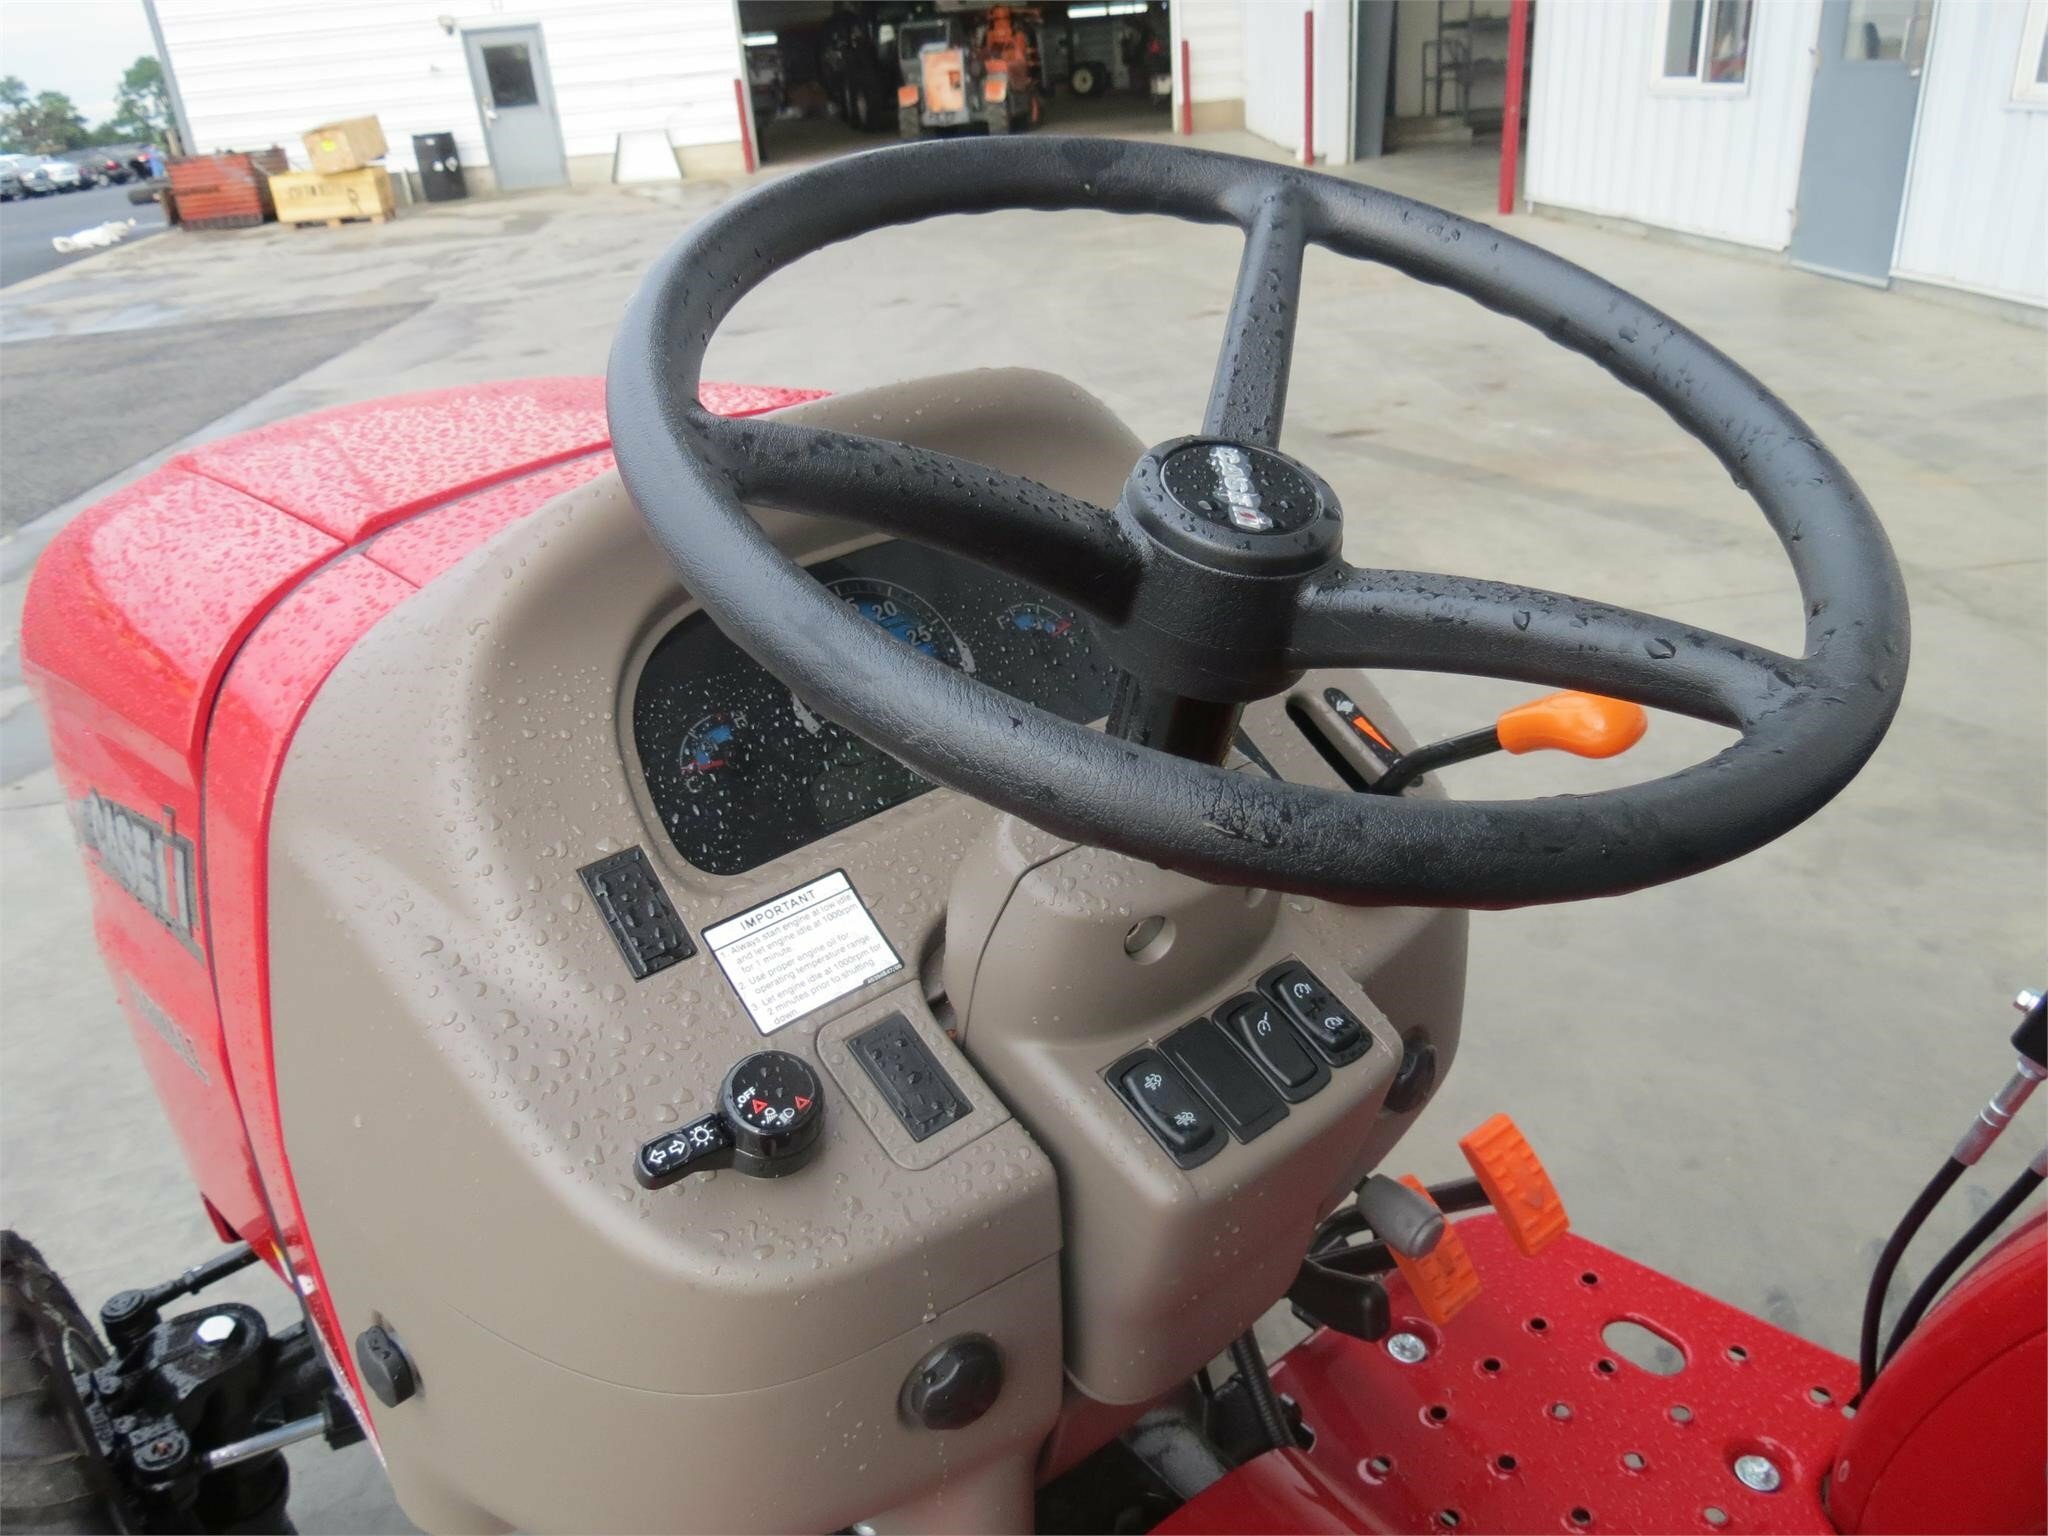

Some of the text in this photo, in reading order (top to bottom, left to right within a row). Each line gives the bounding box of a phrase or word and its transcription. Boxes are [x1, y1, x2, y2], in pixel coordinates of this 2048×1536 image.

[871, 600, 898, 621] 20
[906, 625, 932, 646] 25
[686, 775, 702, 793] C
[730, 937, 761, 954] Always
[761, 927, 781, 940] start
[782, 914, 810, 931] engine
[811, 908, 820, 917] at
[819, 902, 836, 912] low
[740, 889, 815, 930] IMPORTANT
[736, 951, 753, 965] and
[753, 946, 766, 955] let
[766, 933, 795, 950] engine
[796, 925, 813, 936] idle
[813, 919, 822, 928] at
[748, 972, 767, 985] Use
[767, 958, 795, 977] proper
[797, 944, 826, 962] engine
[826, 937, 837, 948] oil
[836, 932, 848, 942] for
[754, 971, 796, 994] operating
[795, 946, 846, 974] temperature
[761, 994, 776, 1006] Let
[777, 980, 807, 999] engine
[807, 972, 823, 984] idle
[824, 967, 833, 975] at
[766, 1007, 775, 1016] 2
[775, 991, 810, 1012] minutes
[810, 980, 830, 996] prior
[830, 975, 841, 984] to
[841, 959, 876, 979] shutting
[737, 1086, 757, 1103] OFF
